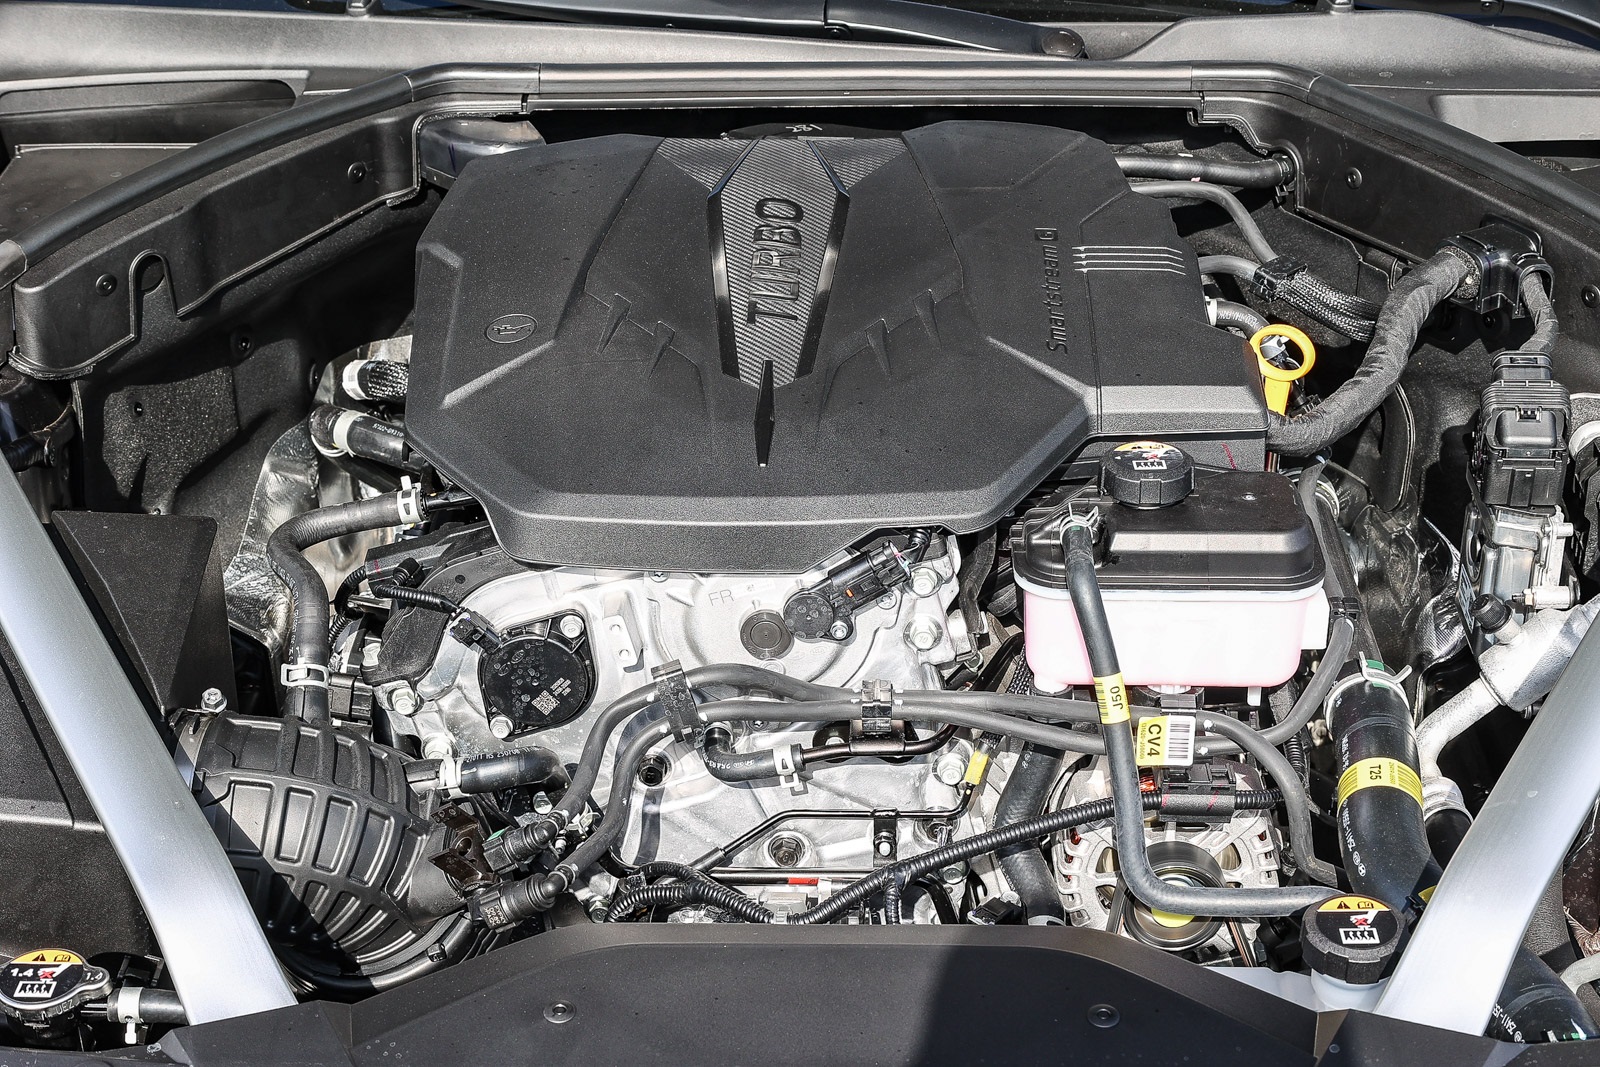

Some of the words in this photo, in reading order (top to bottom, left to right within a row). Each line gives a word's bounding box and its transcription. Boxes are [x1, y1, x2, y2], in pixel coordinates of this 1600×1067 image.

[747, 197, 806, 325] TURBO
[1042, 245, 1069, 354] Smartstream
[708, 589, 735, 607] FR
[1110, 686, 1124, 710] J50
[1146, 723, 1162, 757] CV4
[1369, 764, 1382, 781] T25
[10, 967, 34, 978] 1.4
